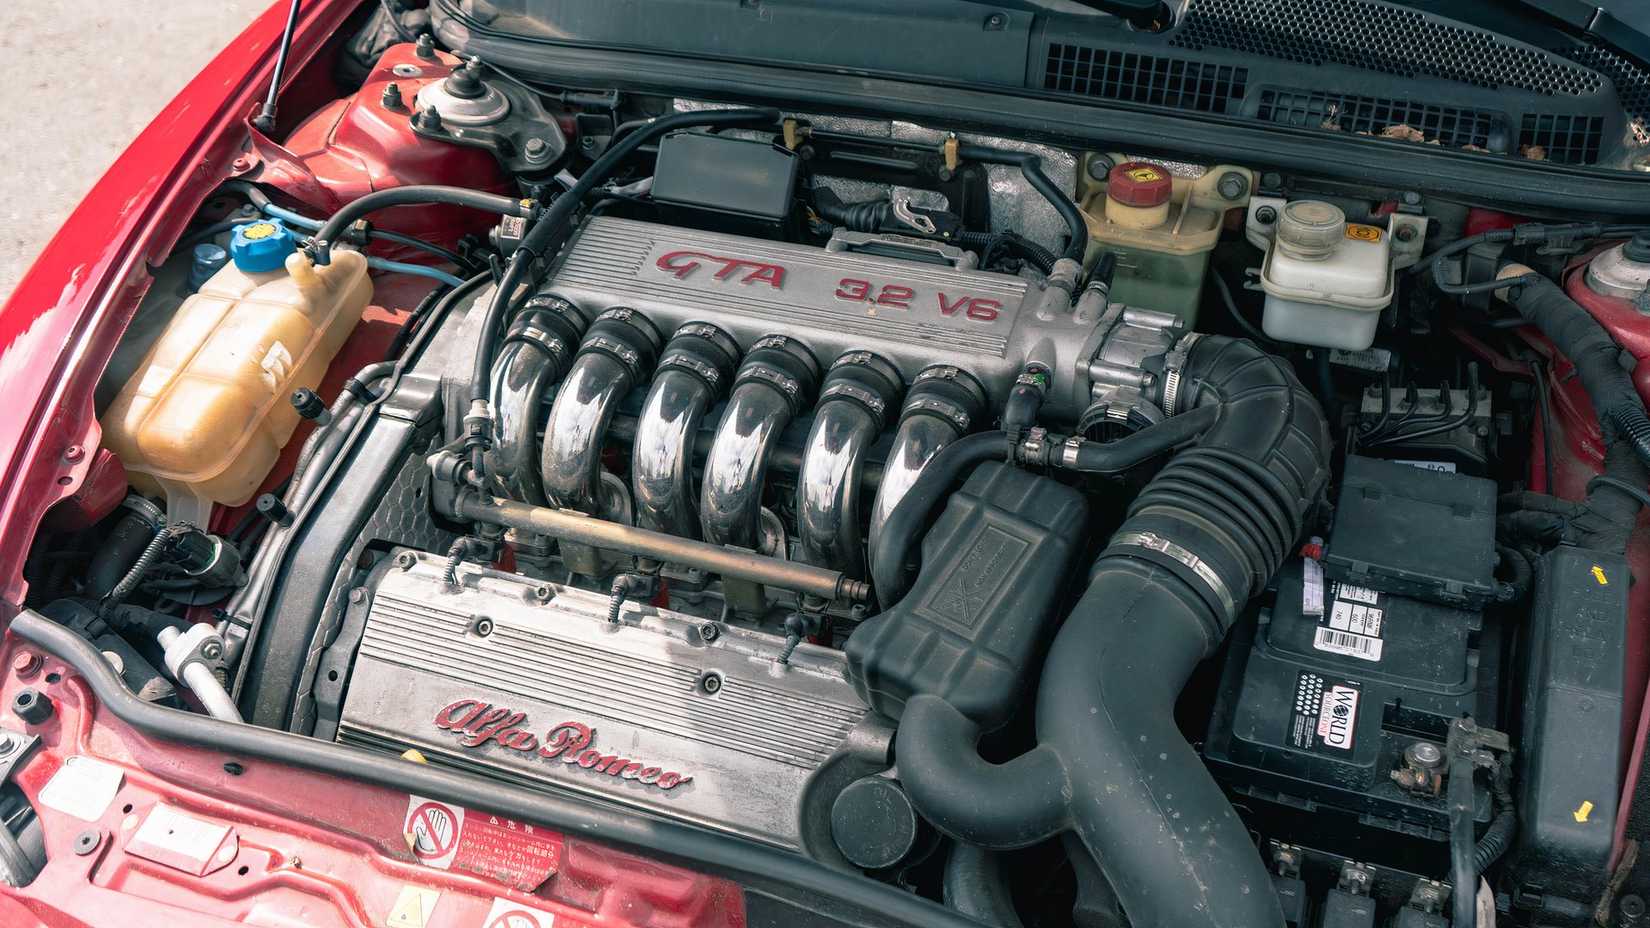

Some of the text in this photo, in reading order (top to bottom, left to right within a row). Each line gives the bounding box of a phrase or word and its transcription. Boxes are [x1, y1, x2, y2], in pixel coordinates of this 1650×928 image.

[655, 250, 1003, 322] GTA 3.2 V6
[434, 699, 694, 790] Alfa Romeo
[1328, 691, 1355, 745] WORLD
